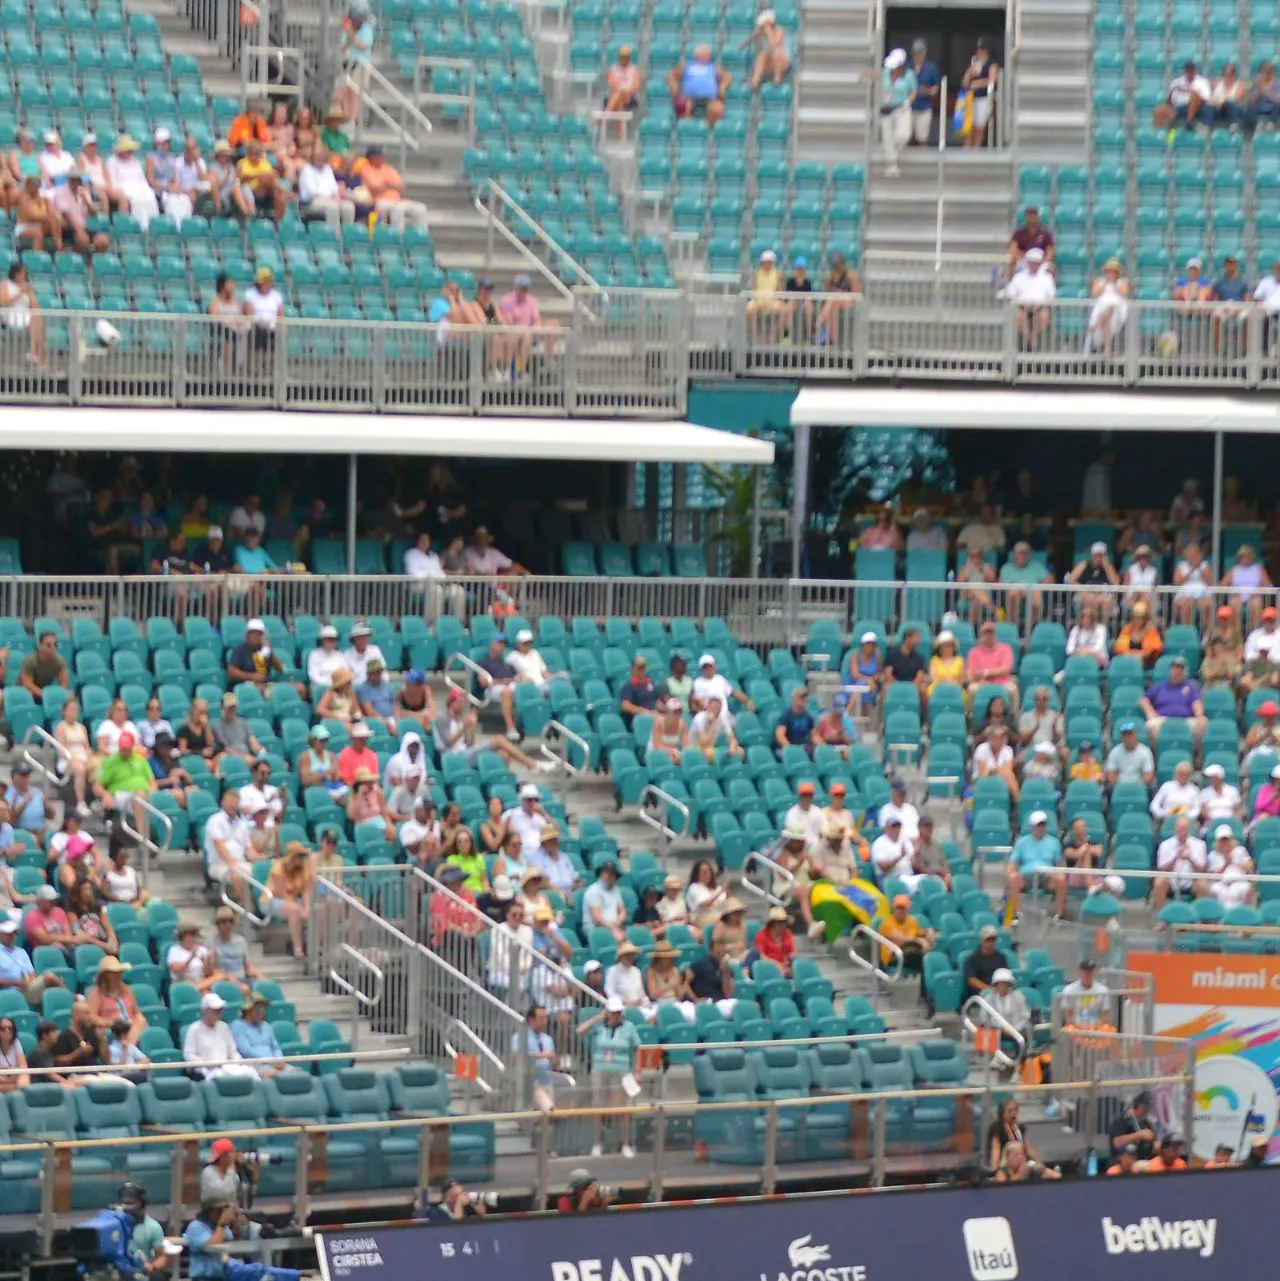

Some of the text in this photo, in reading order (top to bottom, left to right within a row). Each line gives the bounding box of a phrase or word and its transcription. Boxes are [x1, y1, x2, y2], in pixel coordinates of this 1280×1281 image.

[1191, 966, 1266, 990] miami
[329, 1238, 379, 1253] SORANA
[1101, 1216, 1217, 1258] betway
[440, 1241, 473, 1258] 15 4
[972, 1247, 1014, 1272] Itaú
[332, 1252, 384, 1268] CIRSTEA
